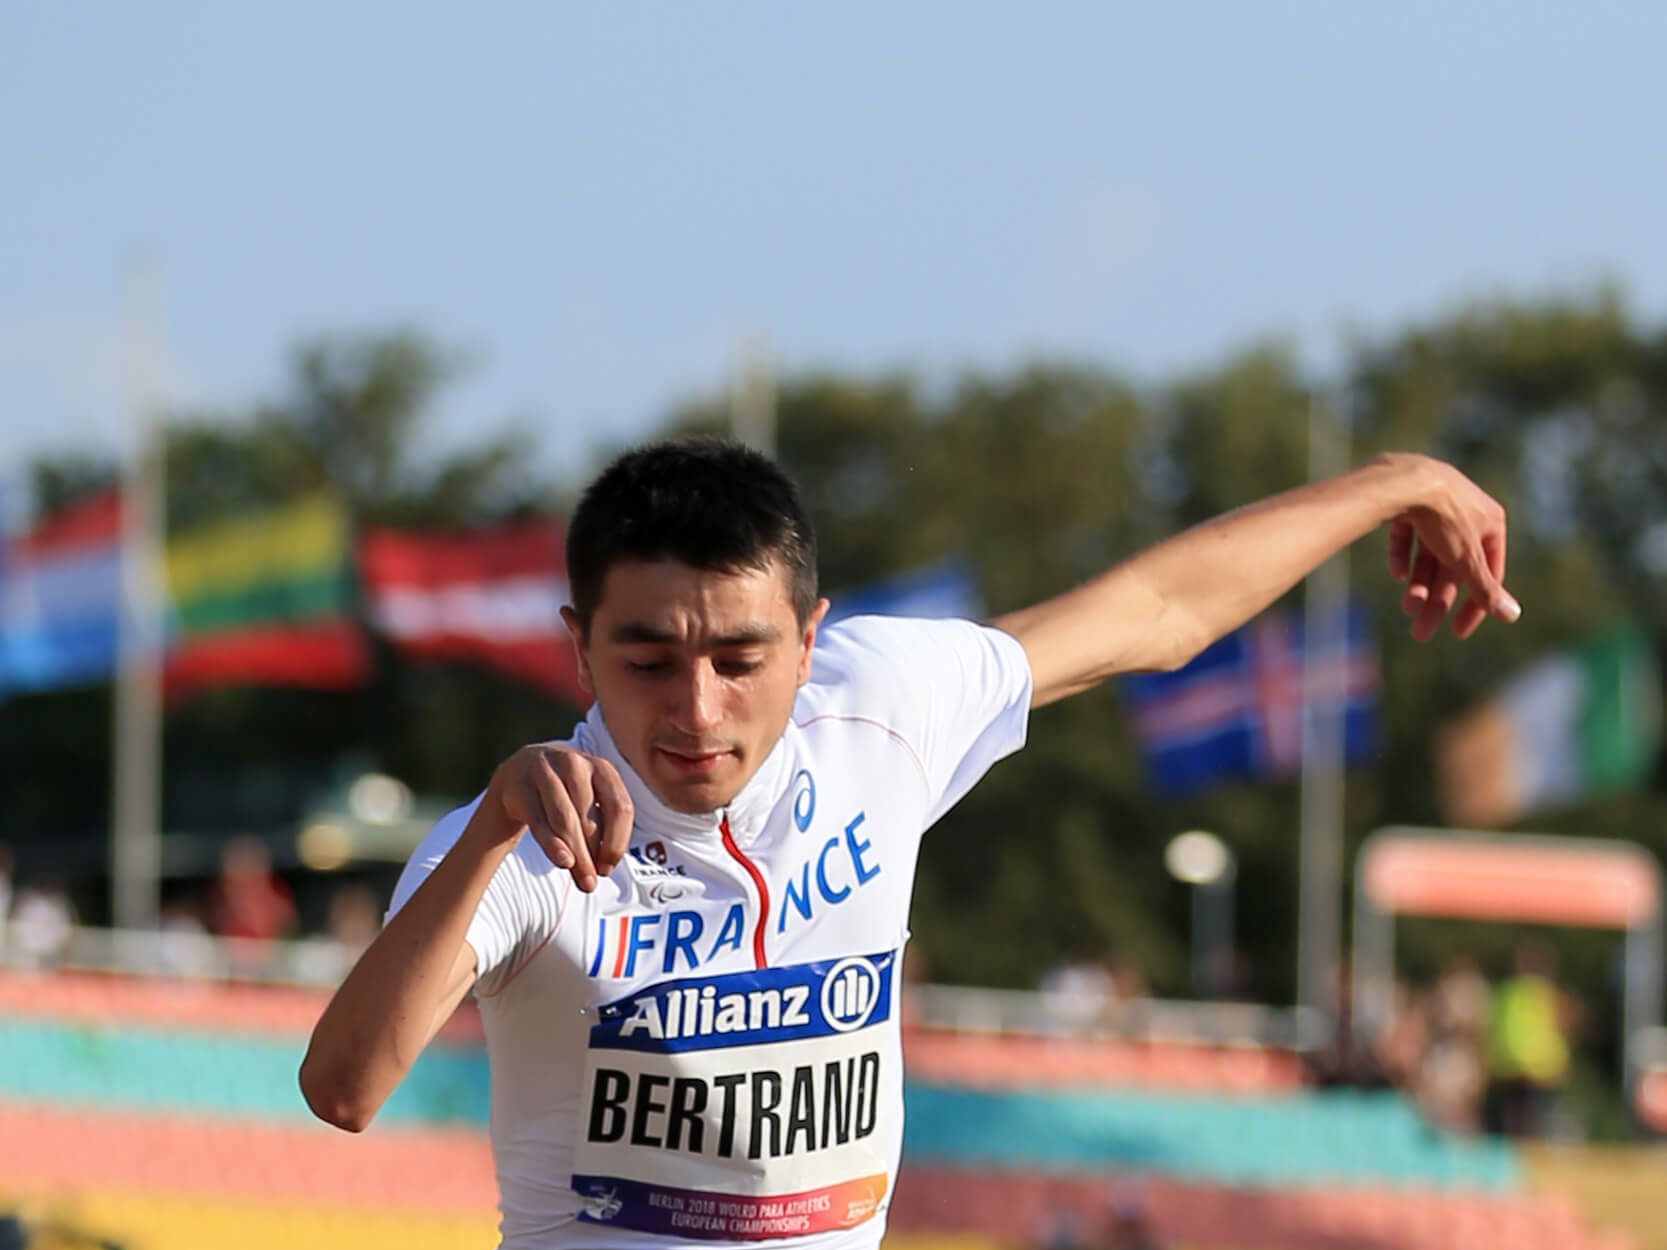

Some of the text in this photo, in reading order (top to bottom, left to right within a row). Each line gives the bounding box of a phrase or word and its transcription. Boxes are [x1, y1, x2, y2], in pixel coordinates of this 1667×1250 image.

[623, 811, 881, 979] FRANCE
[619, 985, 810, 1040] Allianz
[587, 1051, 881, 1161] BERTRAND
[648, 1191, 685, 1211] BERLIN
[688, 1198, 716, 1215] 2018
[759, 1203, 785, 1218] PARA
[785, 1194, 831, 1216] ATHLETICS
[671, 1211, 811, 1233] EUROPEAN CHAMPIONSHIPS
